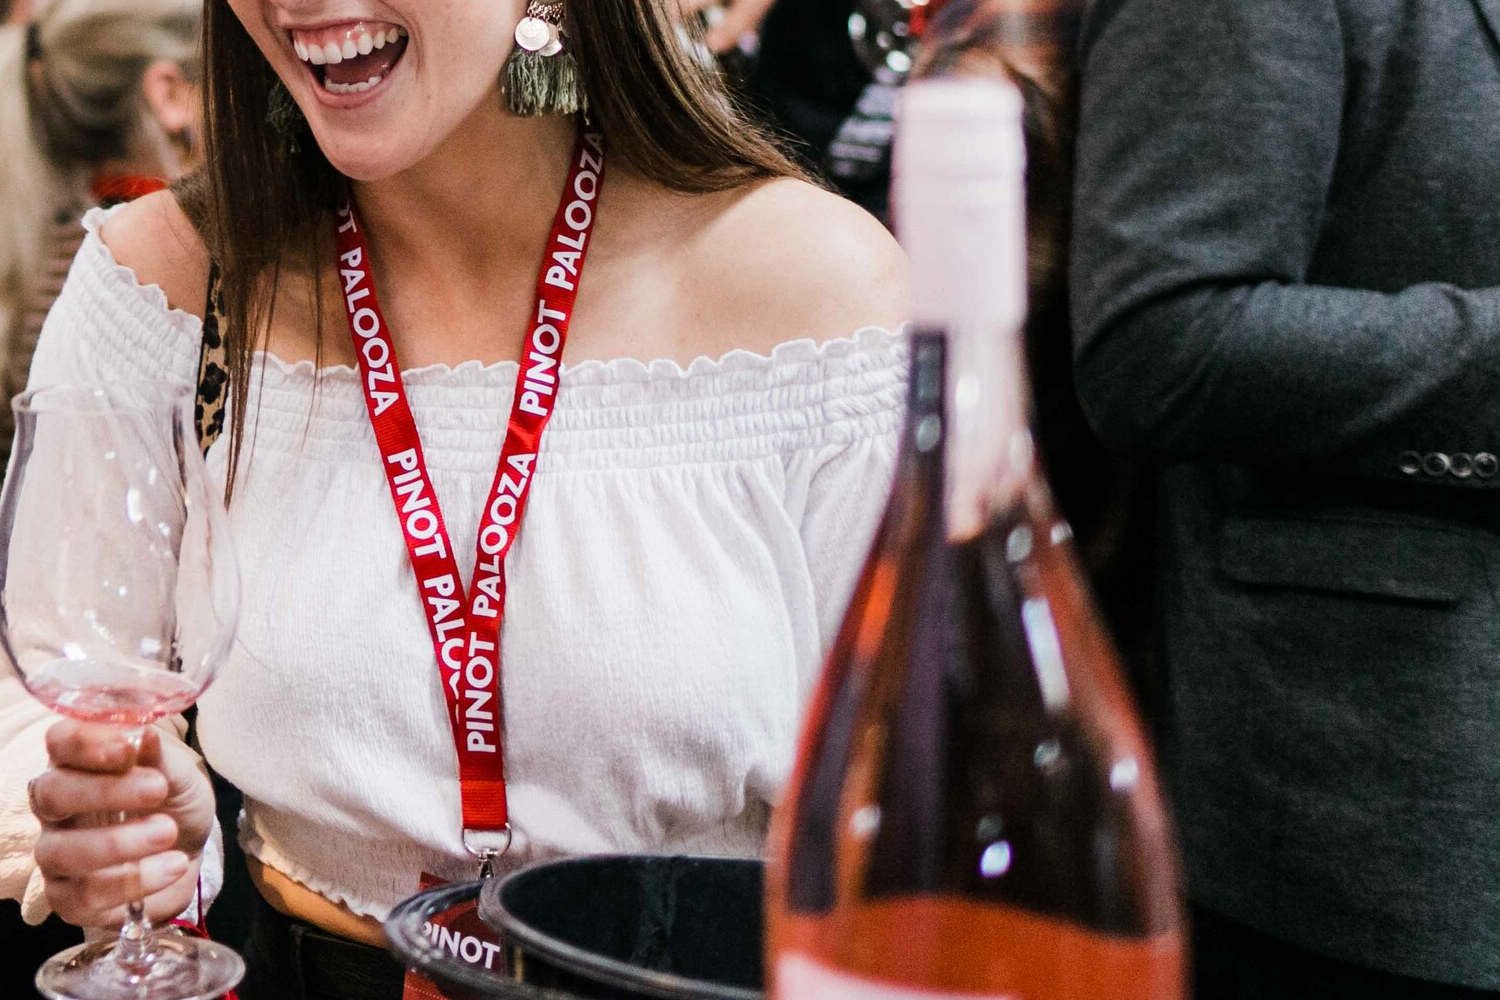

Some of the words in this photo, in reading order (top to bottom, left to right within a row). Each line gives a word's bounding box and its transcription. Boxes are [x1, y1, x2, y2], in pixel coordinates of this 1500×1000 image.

[545, 132, 603, 291] PALOOZA
[519, 299, 567, 417] PINOT
[340, 247, 399, 416] PALOOZA
[388, 447, 446, 559] PINOT
[423, 573, 465, 724] PALO
[472, 452, 536, 618] PALOOZA
[465, 632, 496, 753] PINOT
